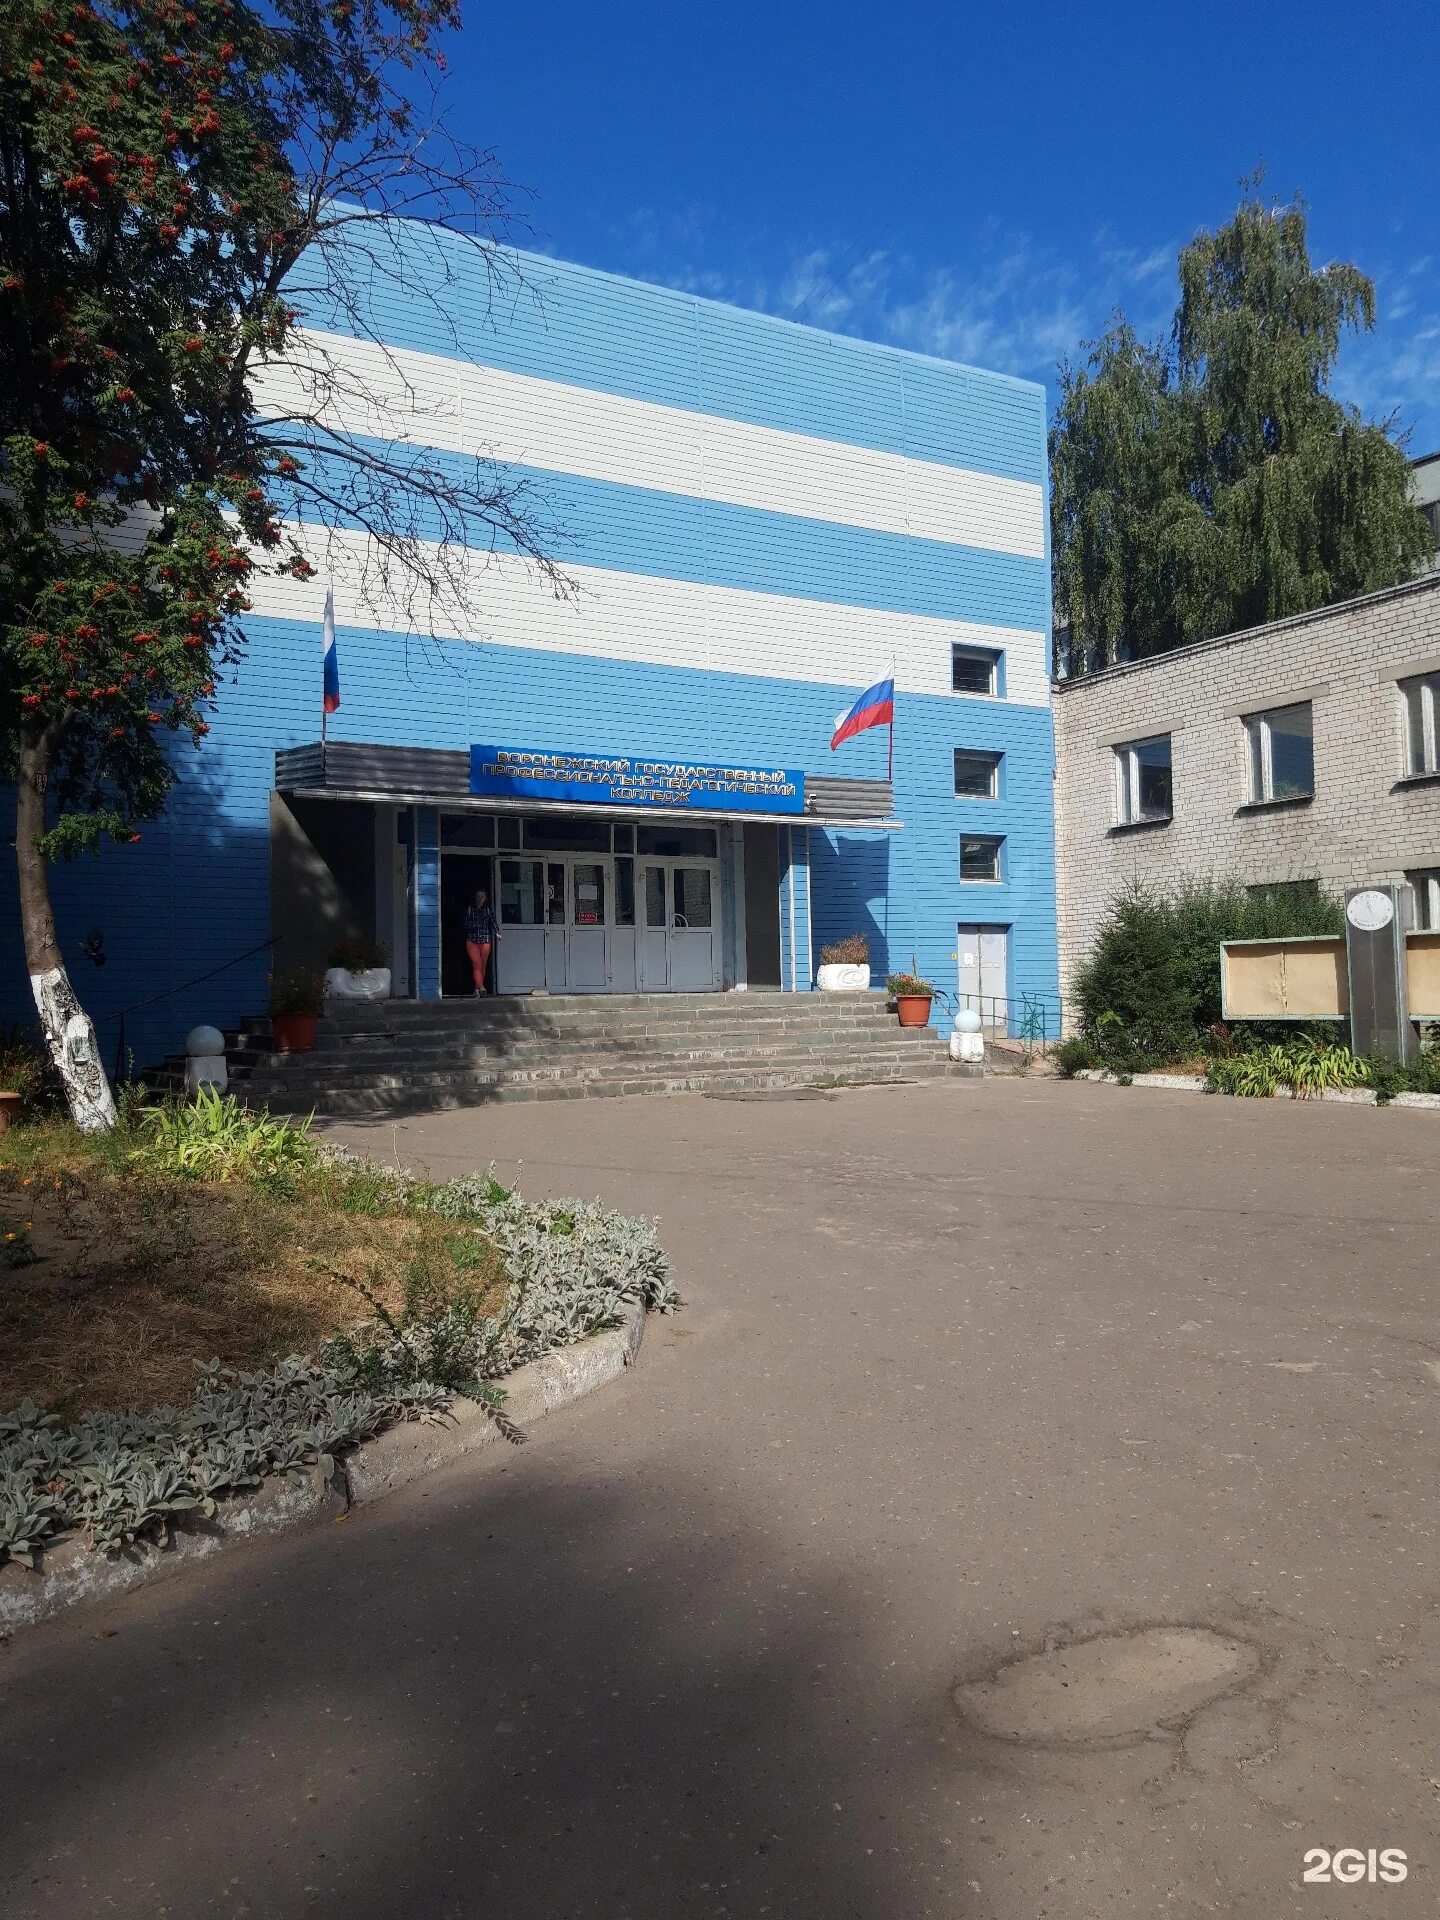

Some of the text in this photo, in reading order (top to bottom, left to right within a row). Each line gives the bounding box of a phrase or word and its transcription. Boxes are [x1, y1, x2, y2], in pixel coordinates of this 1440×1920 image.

[483, 764, 795, 796] ПРОФЕССИОНАЛЬНО-ПЕДАГОГИЧЕСКИЙ
[497, 750, 785, 784] ВОРОНЕЖСКИЙ ГОСУДАРСТВЕННЫЙ
[611, 788, 691, 804] КОЛЛЕДЖ
